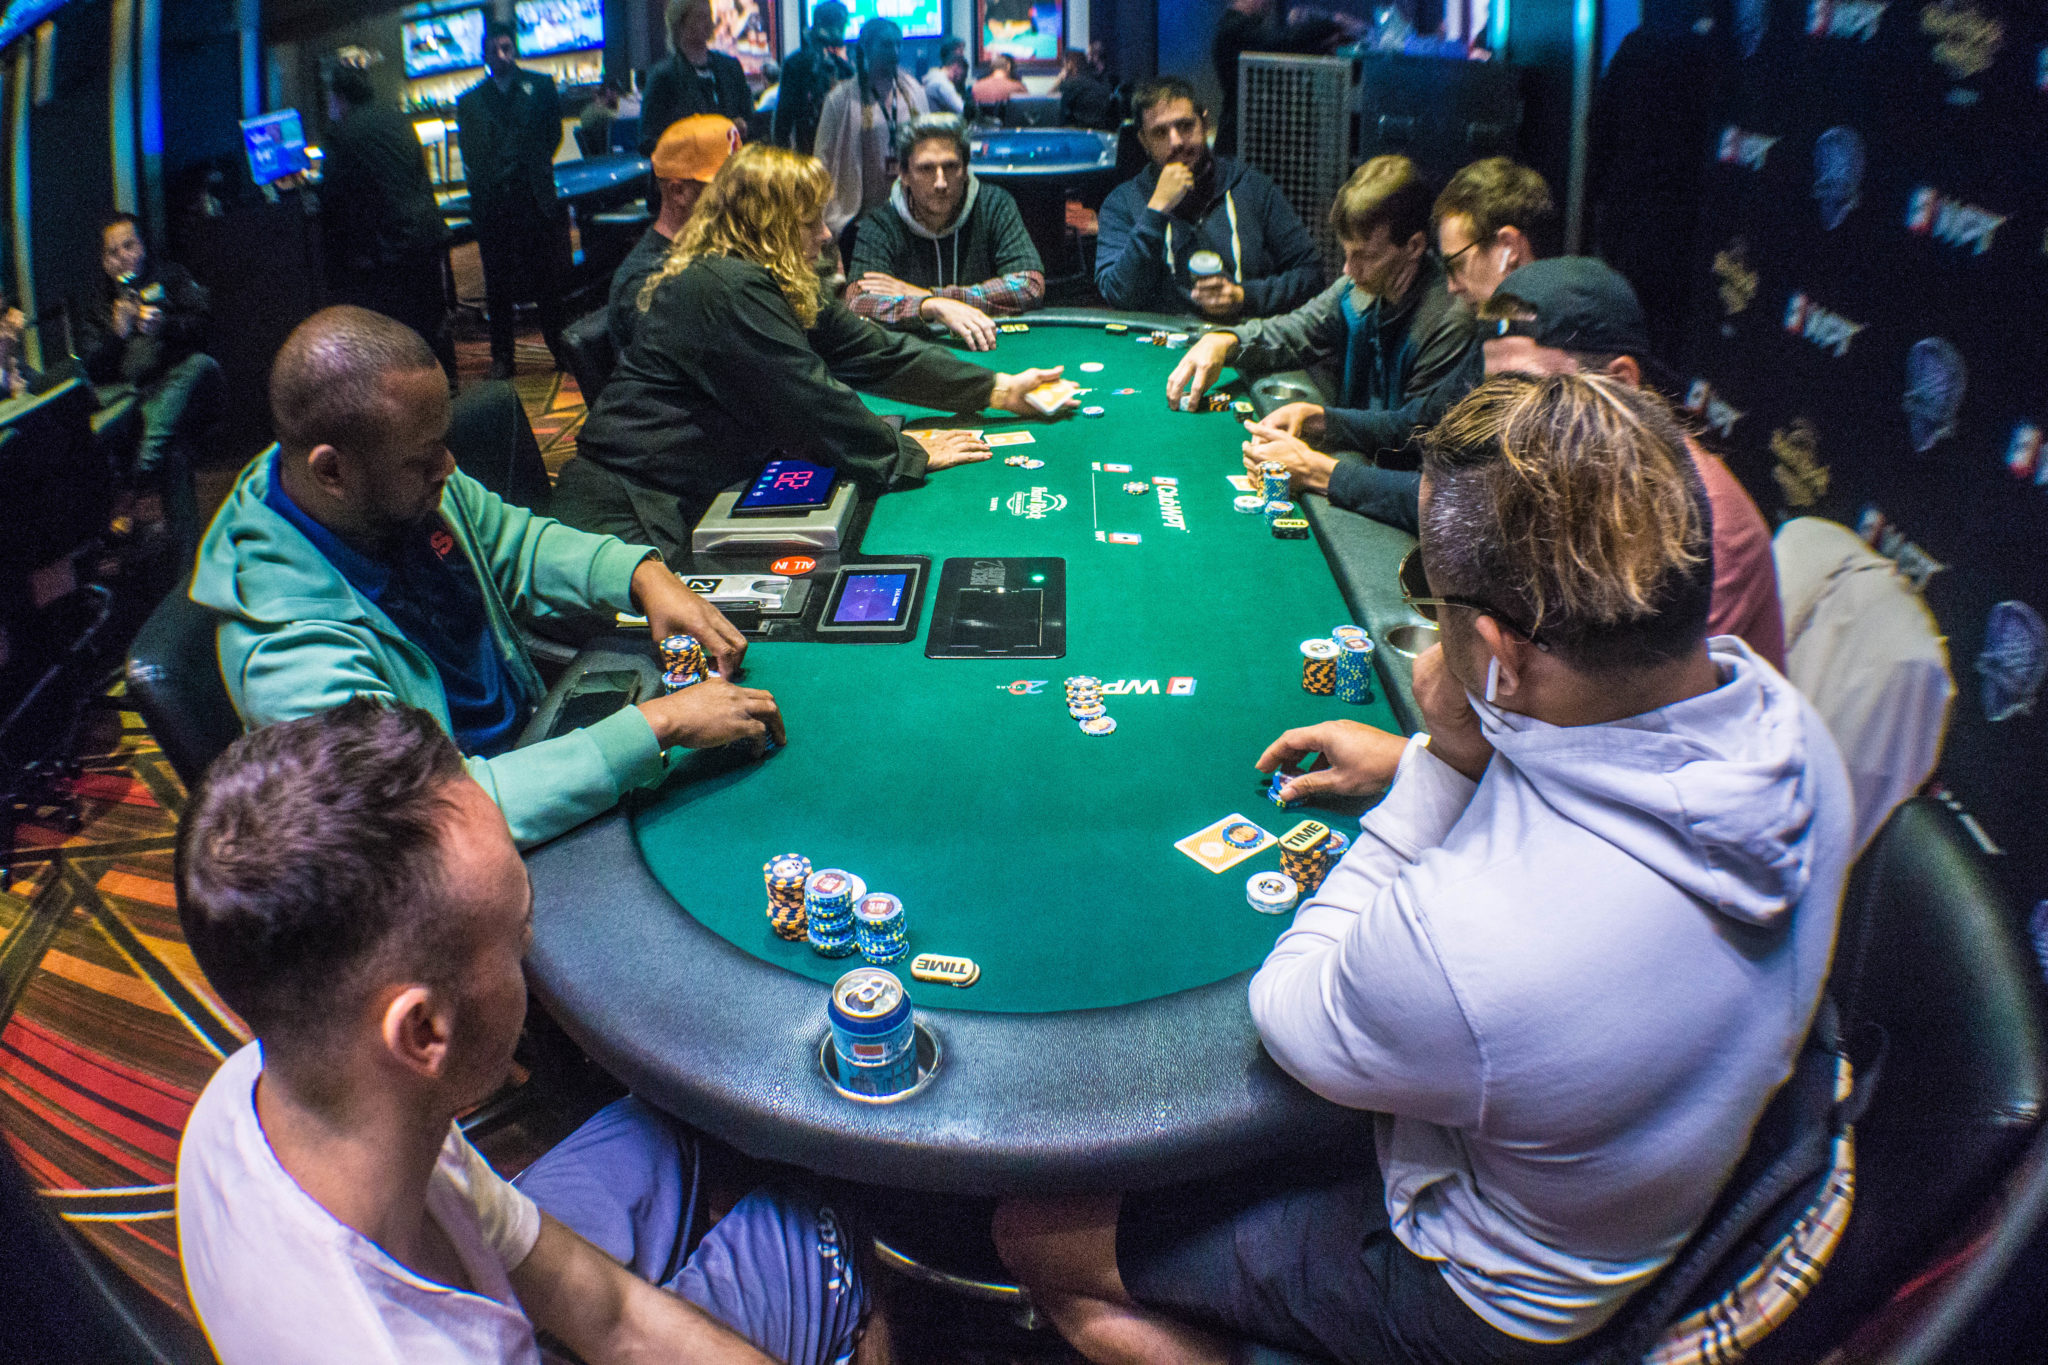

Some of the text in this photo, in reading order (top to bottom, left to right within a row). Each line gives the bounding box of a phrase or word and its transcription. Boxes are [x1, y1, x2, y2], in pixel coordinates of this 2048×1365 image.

[1156, 485, 1186, 530] ClubWPT
[774, 560, 815, 570] ALL IN
[1099, 679, 1160, 695] WP
[1284, 821, 1324, 848] TIME
[915, 958, 967, 975] TIME
